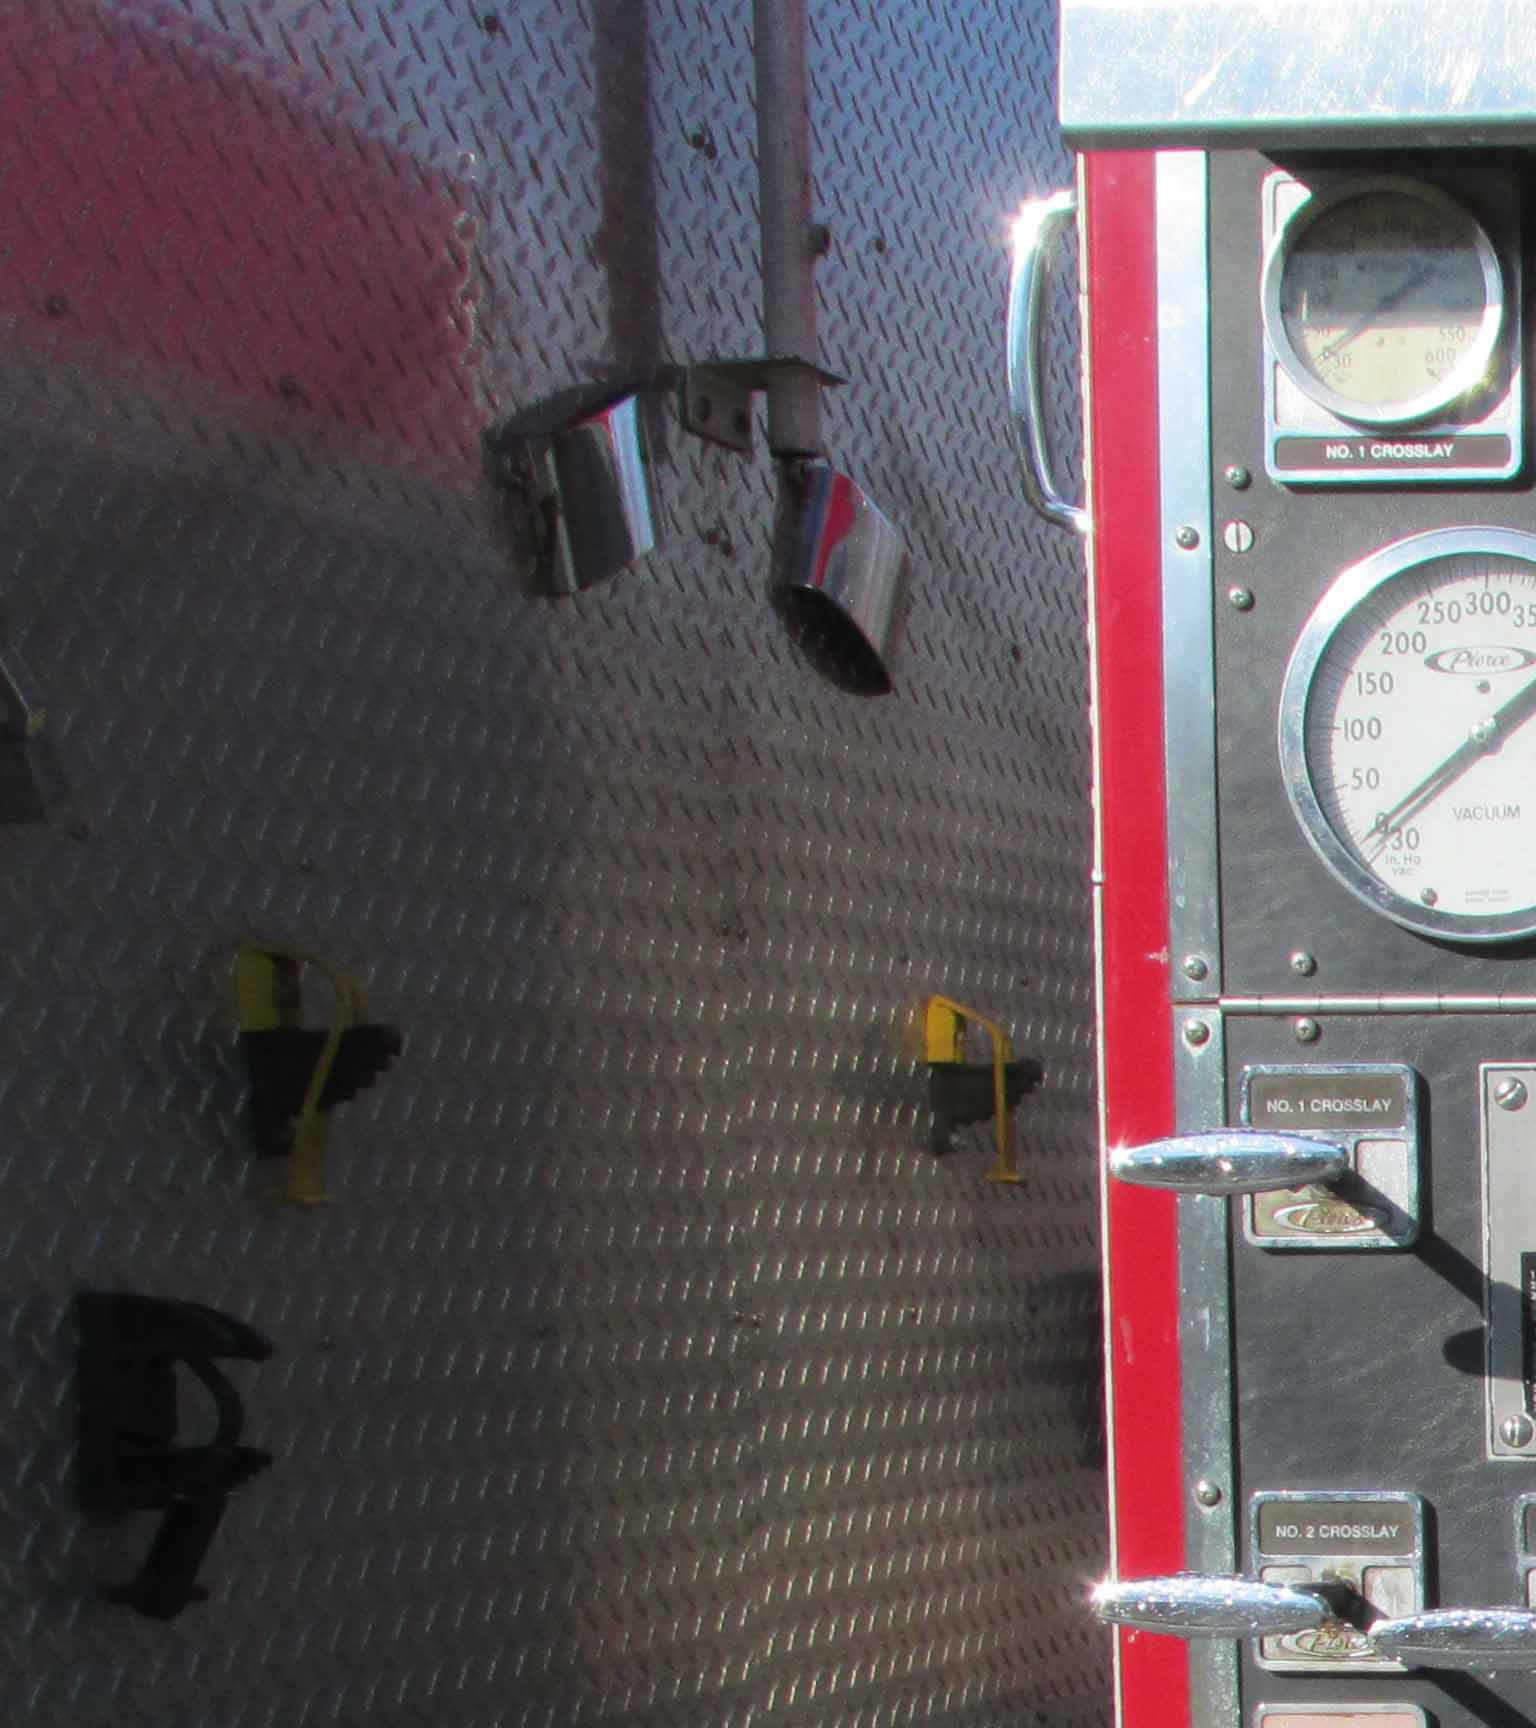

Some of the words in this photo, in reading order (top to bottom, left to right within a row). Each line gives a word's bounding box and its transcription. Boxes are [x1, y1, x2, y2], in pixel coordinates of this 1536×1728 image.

[1326, 443, 1354, 459] NO.
[1359, 443, 1366, 459] 1
[1370, 443, 1453, 459] CROSSLAY
[1418, 602, 1461, 624] 250
[1466, 592, 1511, 614] 300
[1380, 632, 1427, 655] 200
[1357, 672, 1393, 695] 150
[1343, 718, 1381, 739] 100
[1352, 768, 1379, 789] 50
[1452, 805, 1520, 821] VACUUM
[1267, 1098, 1292, 1112] NO.
[1299, 1098, 1305, 1112] 1
[1310, 1098, 1391, 1112] CROSSLAY
[1275, 1525, 1301, 1538] NO.
[1305, 1525, 1314, 1538] 2
[1319, 1524, 1399, 1539] CROSSLAY
